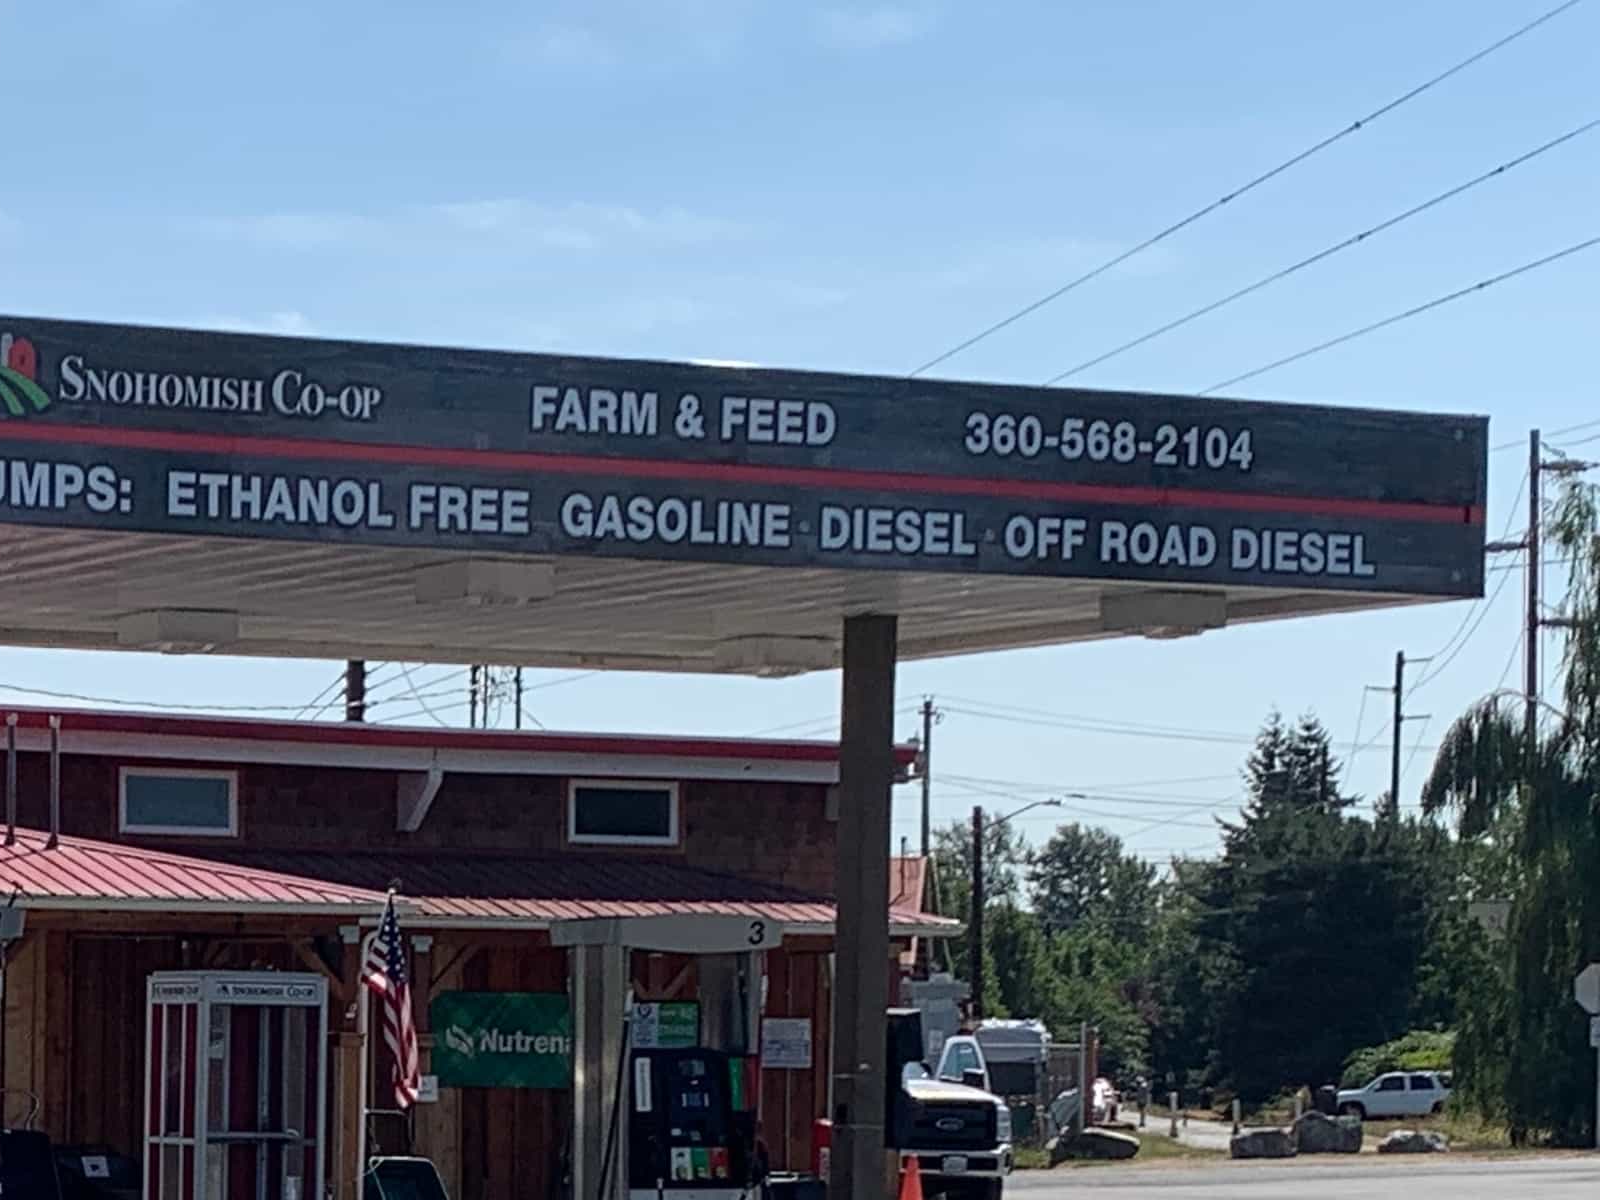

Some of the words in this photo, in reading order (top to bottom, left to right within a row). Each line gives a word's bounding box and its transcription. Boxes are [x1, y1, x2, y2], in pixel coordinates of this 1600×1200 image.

[58, 354, 265, 413] SNOHOMISH
[271, 368, 382, 420] CO-OP
[531, 385, 659, 436] FARM
[674, 393, 705, 439] &
[720, 396, 837, 446] FEED
[964, 411, 1254, 471] 360-568-2104
[167, 470, 393, 529] ETHANOL
[409, 485, 530, 535] FREE
[560, 492, 791, 548] GASOLINE
[821, 505, 977, 556] DIESEL
[1004, 514, 1087, 561] OFF
[1100, 520, 1218, 567] ROAD
[1231, 528, 1376, 577] DIESEL
[748, 921, 765, 945] 3
